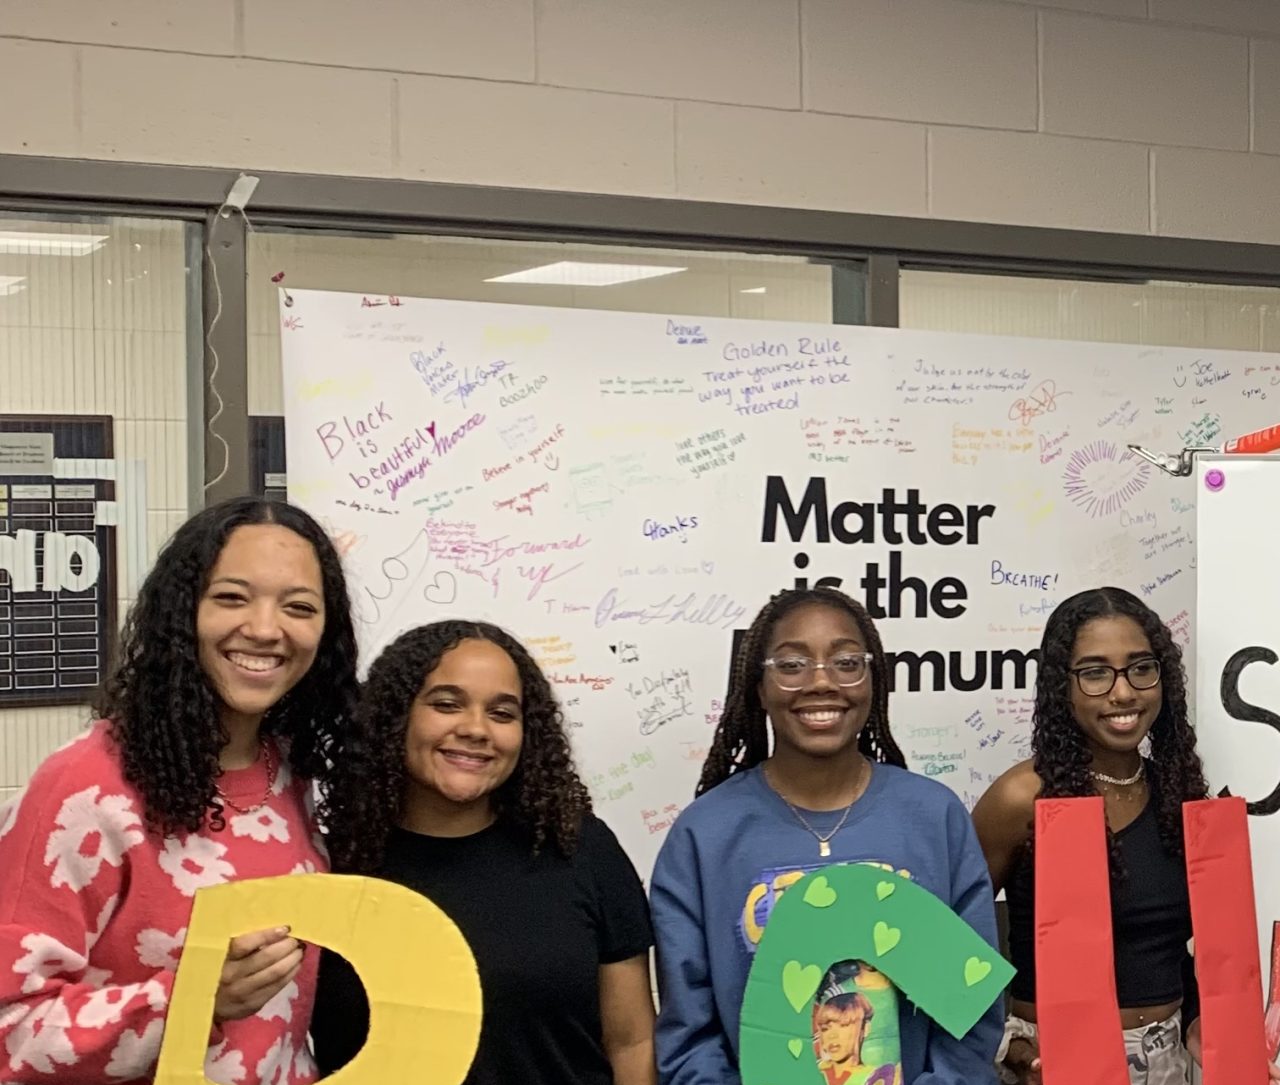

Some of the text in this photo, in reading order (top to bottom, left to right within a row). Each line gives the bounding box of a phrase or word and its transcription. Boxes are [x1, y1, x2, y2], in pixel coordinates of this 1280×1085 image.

[722, 337, 842, 361] Golden Rule
[701, 368, 745, 383] Treat
[824, 354, 852, 367] the
[697, 386, 733, 406] way
[770, 377, 806, 392] want
[809, 374, 826, 385] to
[829, 371, 851, 385] be
[734, 391, 800, 416] treated
[316, 400, 393, 461] Black
[348, 427, 430, 490] beautiful
[356, 438, 378, 458] is
[760, 475, 997, 546] Matter
[860, 550, 969, 620] the
[990, 559, 1059, 592] BREATHE!
